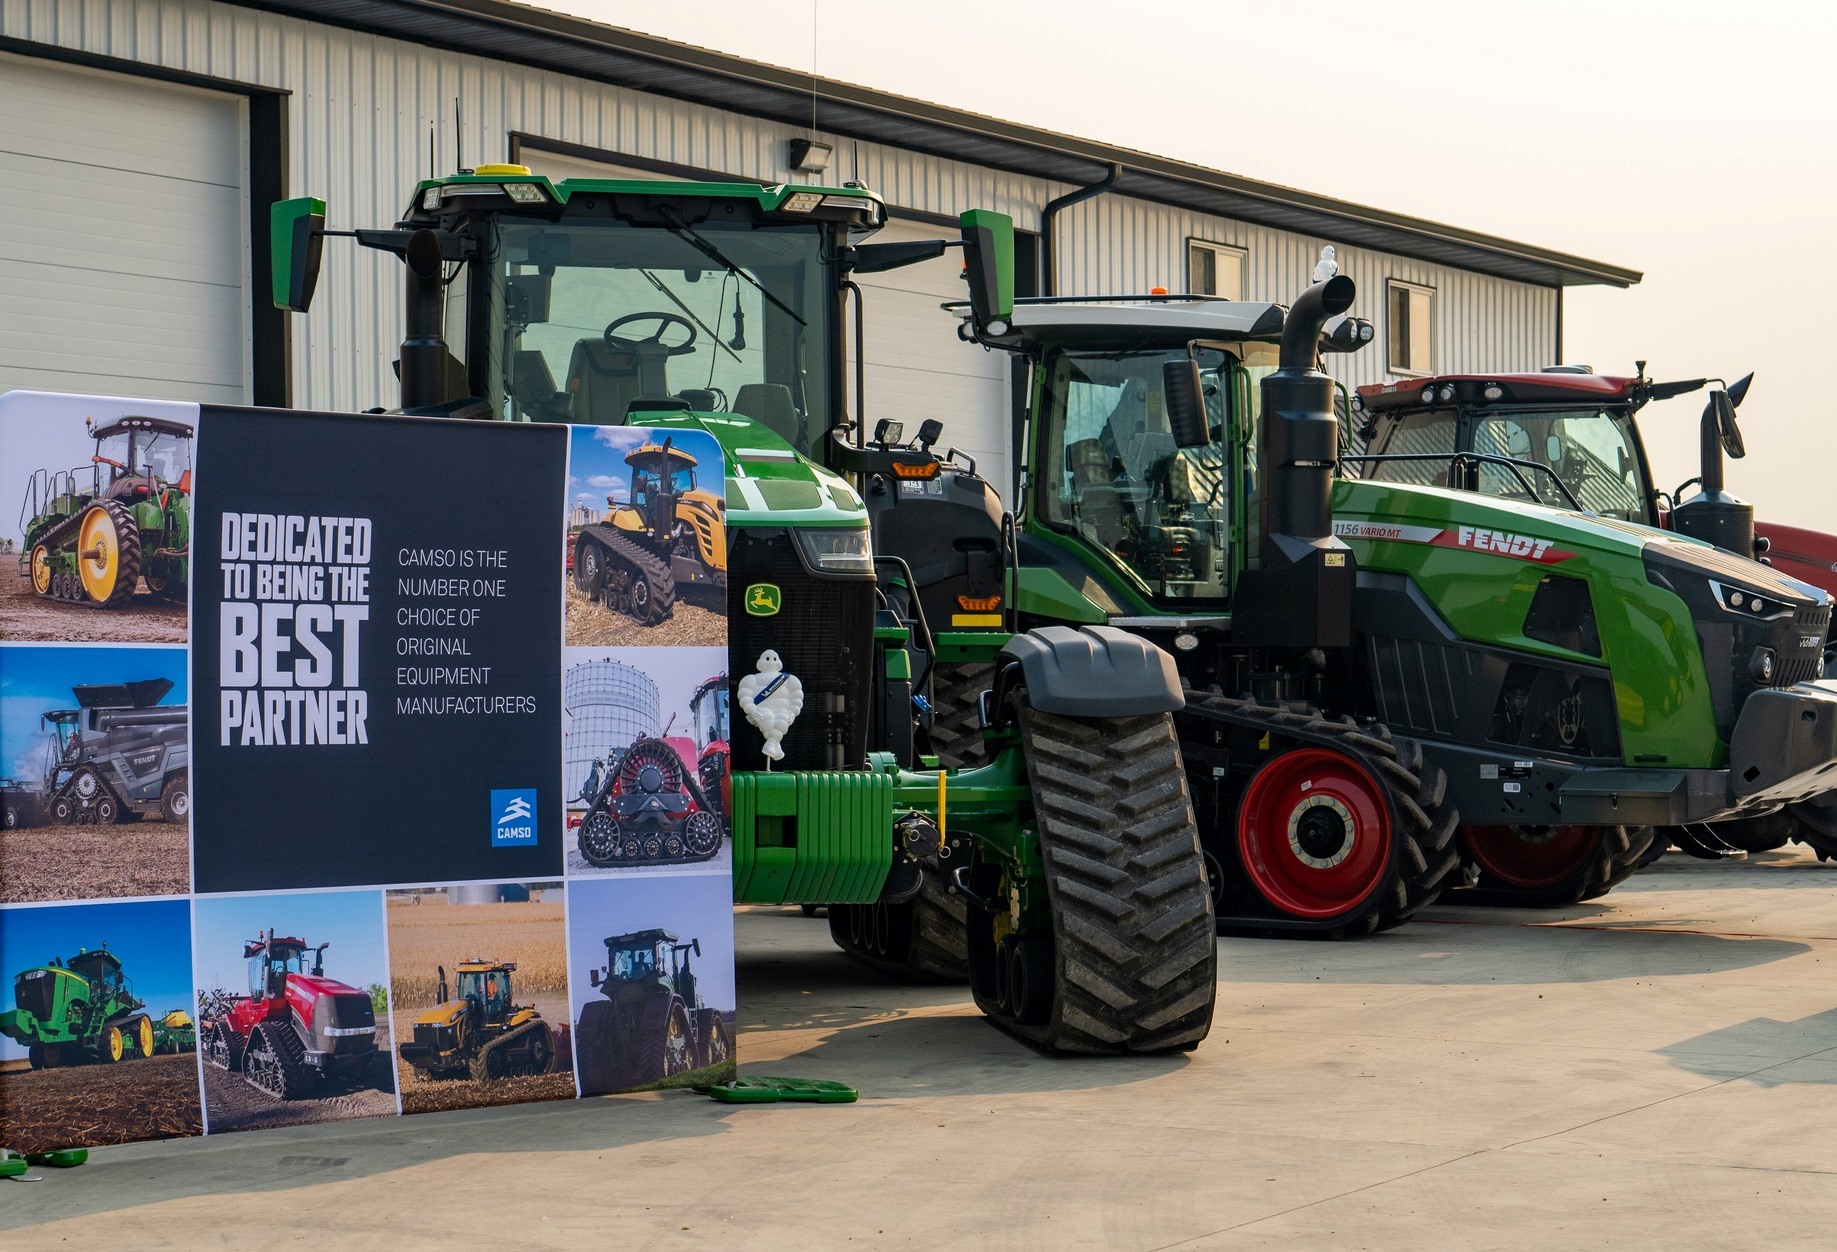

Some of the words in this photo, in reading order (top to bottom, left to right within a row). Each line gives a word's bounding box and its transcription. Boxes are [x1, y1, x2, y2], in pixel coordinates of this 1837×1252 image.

[221, 512, 372, 564] DEDICATED
[1334, 523, 1359, 535] 1156
[1360, 527, 1386, 537] VARIO
[1387, 528, 1402, 538] MT
[1458, 525, 1555, 559] FENDT
[399, 548, 456, 567] CAMSO
[460, 550, 474, 568] IS
[477, 550, 508, 568] THE
[221, 562, 250, 600] TO
[257, 563, 325, 601] BEING
[328, 566, 370, 602] THE
[398, 578, 470, 597] NUMBER
[473, 579, 506, 597] ONE
[397, 608, 456, 626] CHOICE
[460, 608, 481, 626] OF
[220, 601, 369, 688] BEST
[396, 637, 472, 656] ORIGINAL
[397, 667, 492, 686] EQUIPMENT
[397, 696, 537, 715] MANUFACTURERS
[220, 690, 369, 746] PARTNER
[497, 827, 532, 839] CAMSO
